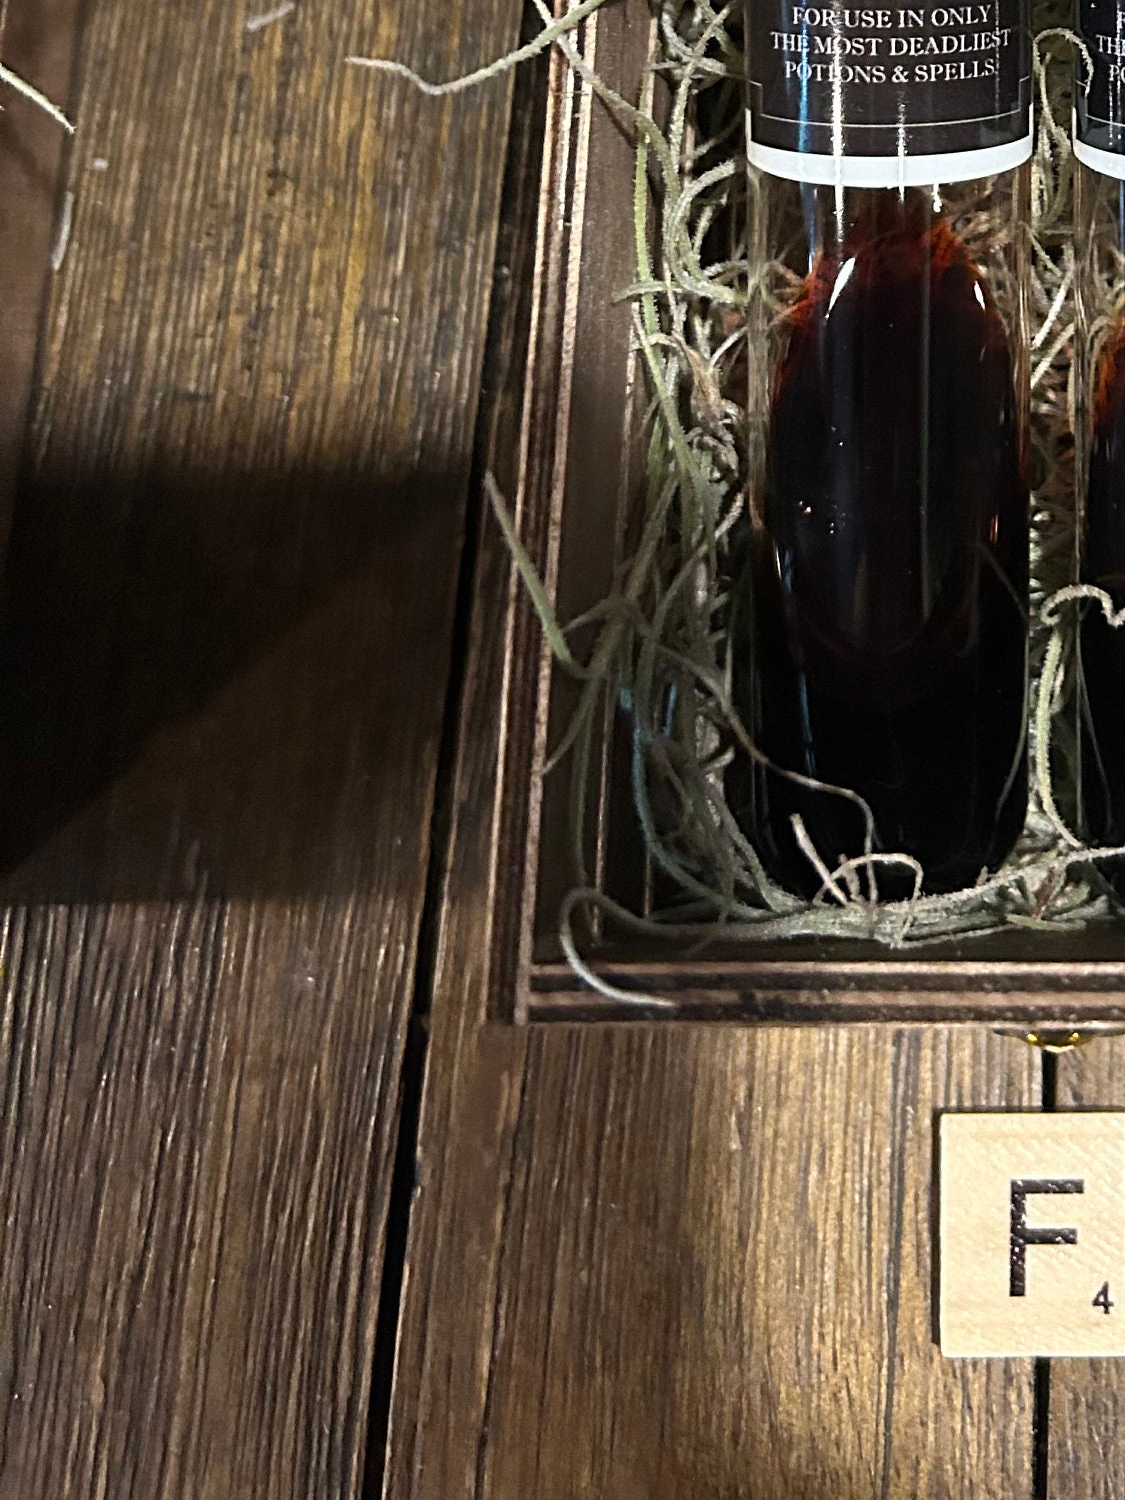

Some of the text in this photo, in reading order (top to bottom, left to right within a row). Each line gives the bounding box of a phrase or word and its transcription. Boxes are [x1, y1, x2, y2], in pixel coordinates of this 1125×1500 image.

[792, 3, 992, 29] FOR USE IN ONLY
[770, 28, 1012, 58] THE MOST DEADLIEST
[784, 60, 887, 84] POTIONS
[891, 65, 910, 83] &
[1009, 1178, 1085, 1297] F
[1091, 1281, 1115, 1315] 4
